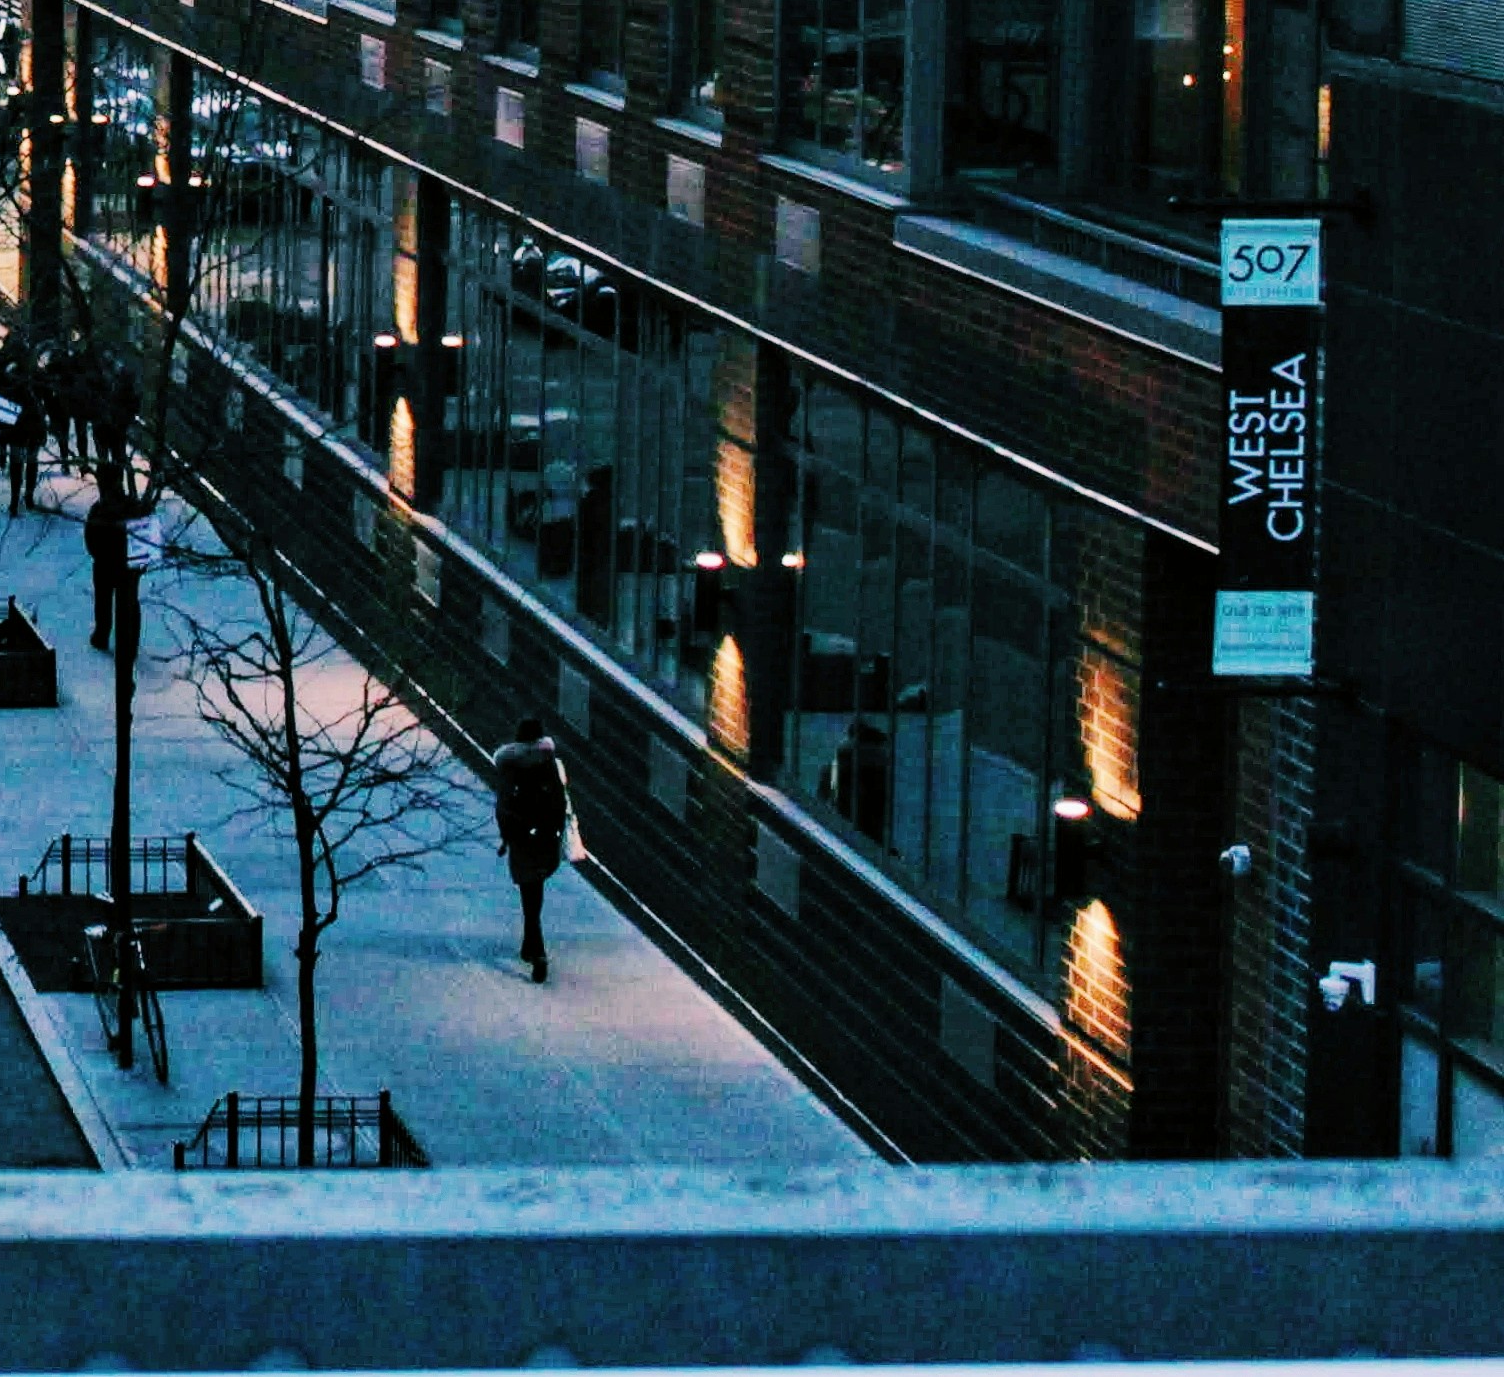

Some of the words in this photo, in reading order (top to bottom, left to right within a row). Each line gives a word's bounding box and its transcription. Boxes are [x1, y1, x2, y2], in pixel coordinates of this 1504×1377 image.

[1228, 244, 1311, 282] 507
[1228, 390, 1266, 505] WEST
[1266, 352, 1307, 541] CHELSEA
